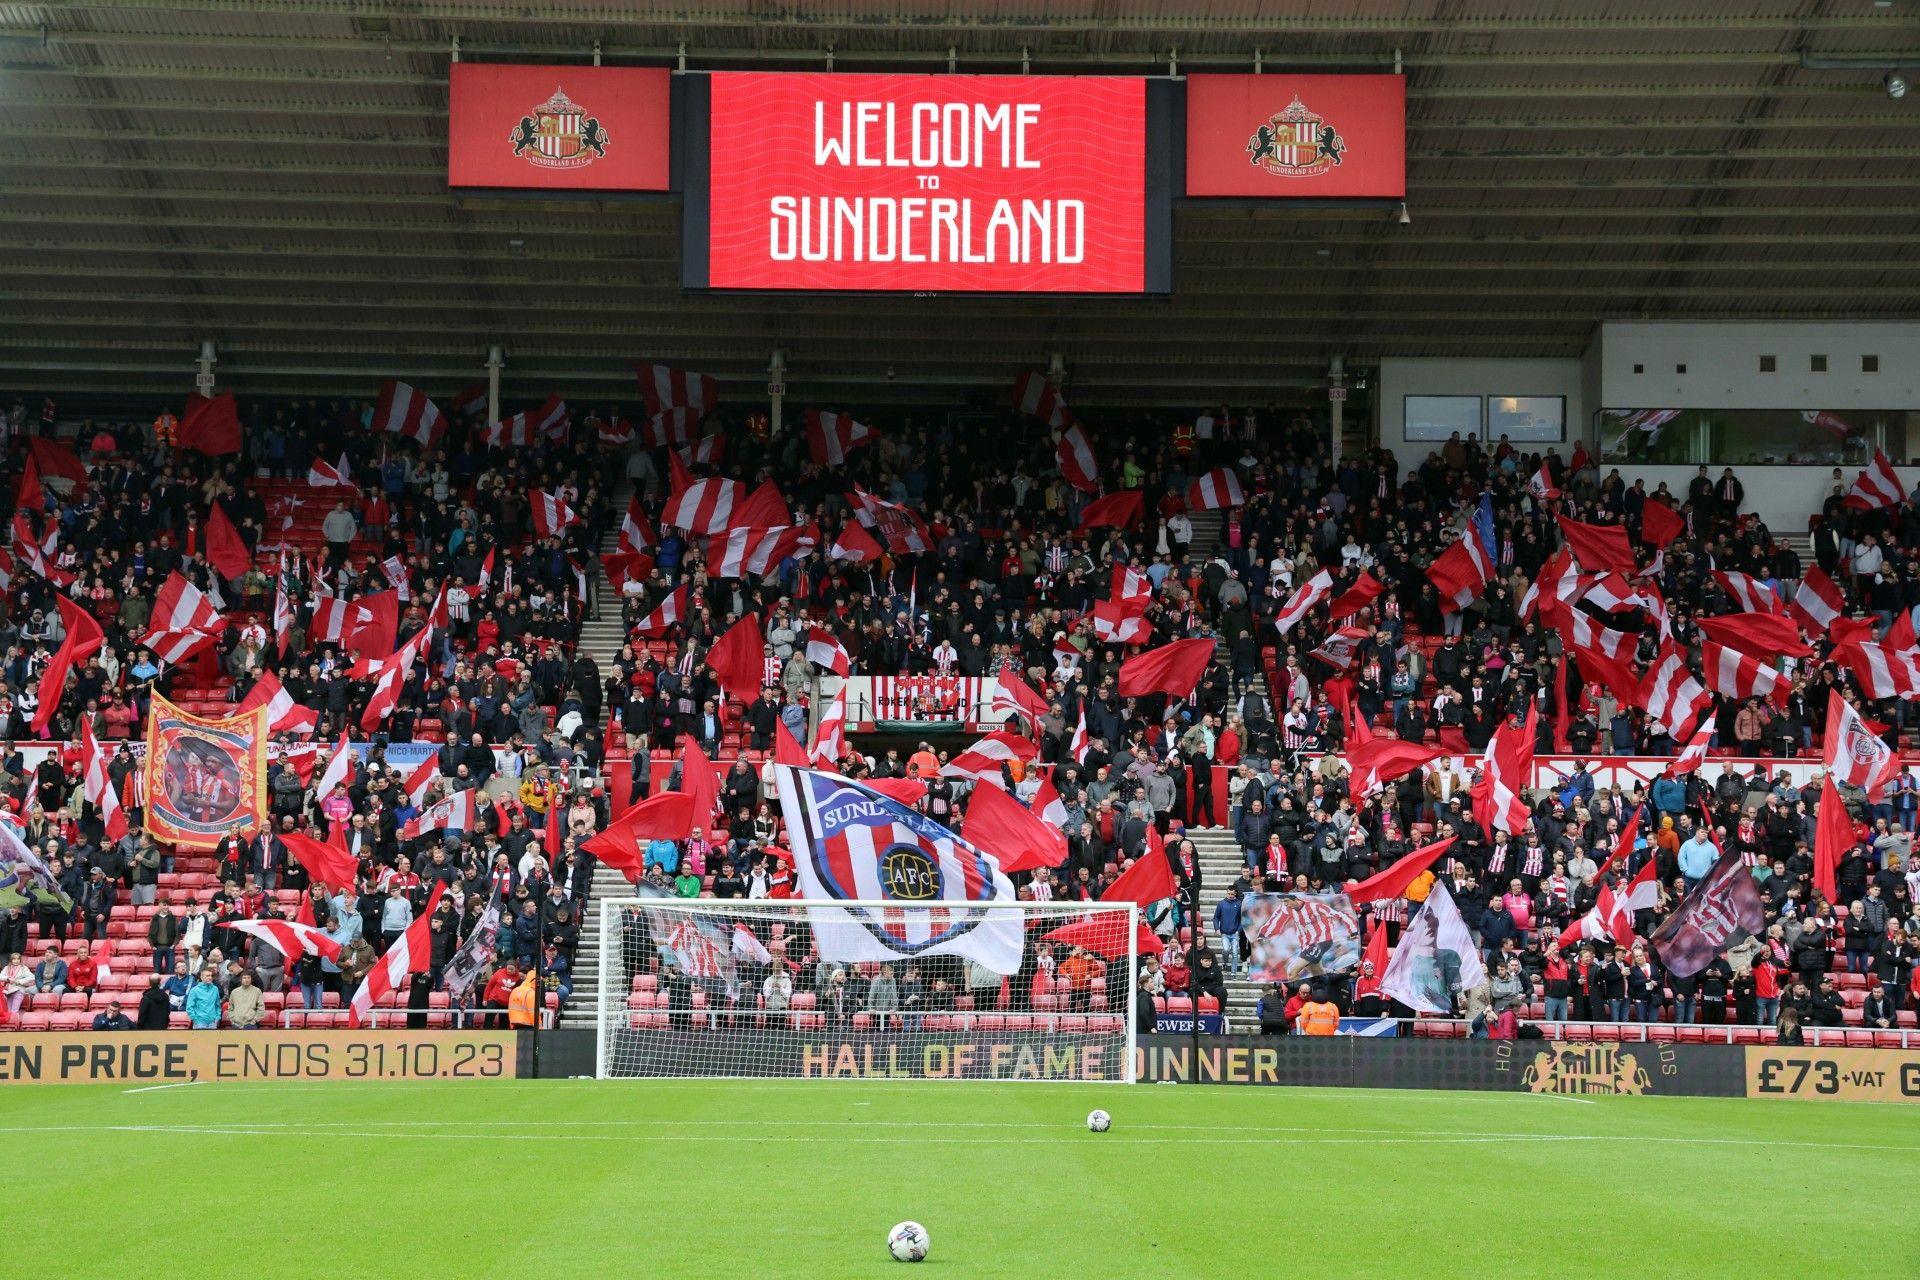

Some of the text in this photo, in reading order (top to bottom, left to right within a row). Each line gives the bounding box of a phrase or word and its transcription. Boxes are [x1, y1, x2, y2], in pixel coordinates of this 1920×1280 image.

[815, 101, 1041, 168] WELCOME
[532, 156, 570, 167] SUNDERLAND
[1269, 164, 1307, 175] SUNDERLAND
[916, 175, 940, 190] TO
[770, 196, 1085, 264] SUNDERLAND
[878, 696, 910, 707] ROKER
[60, 1043, 199, 1082] PRICE,
[216, 1043, 330, 1078] ENDS
[345, 1043, 503, 1078] 31.10.23
[803, 1044, 1279, 1083] HALL OF FAME DINNER
